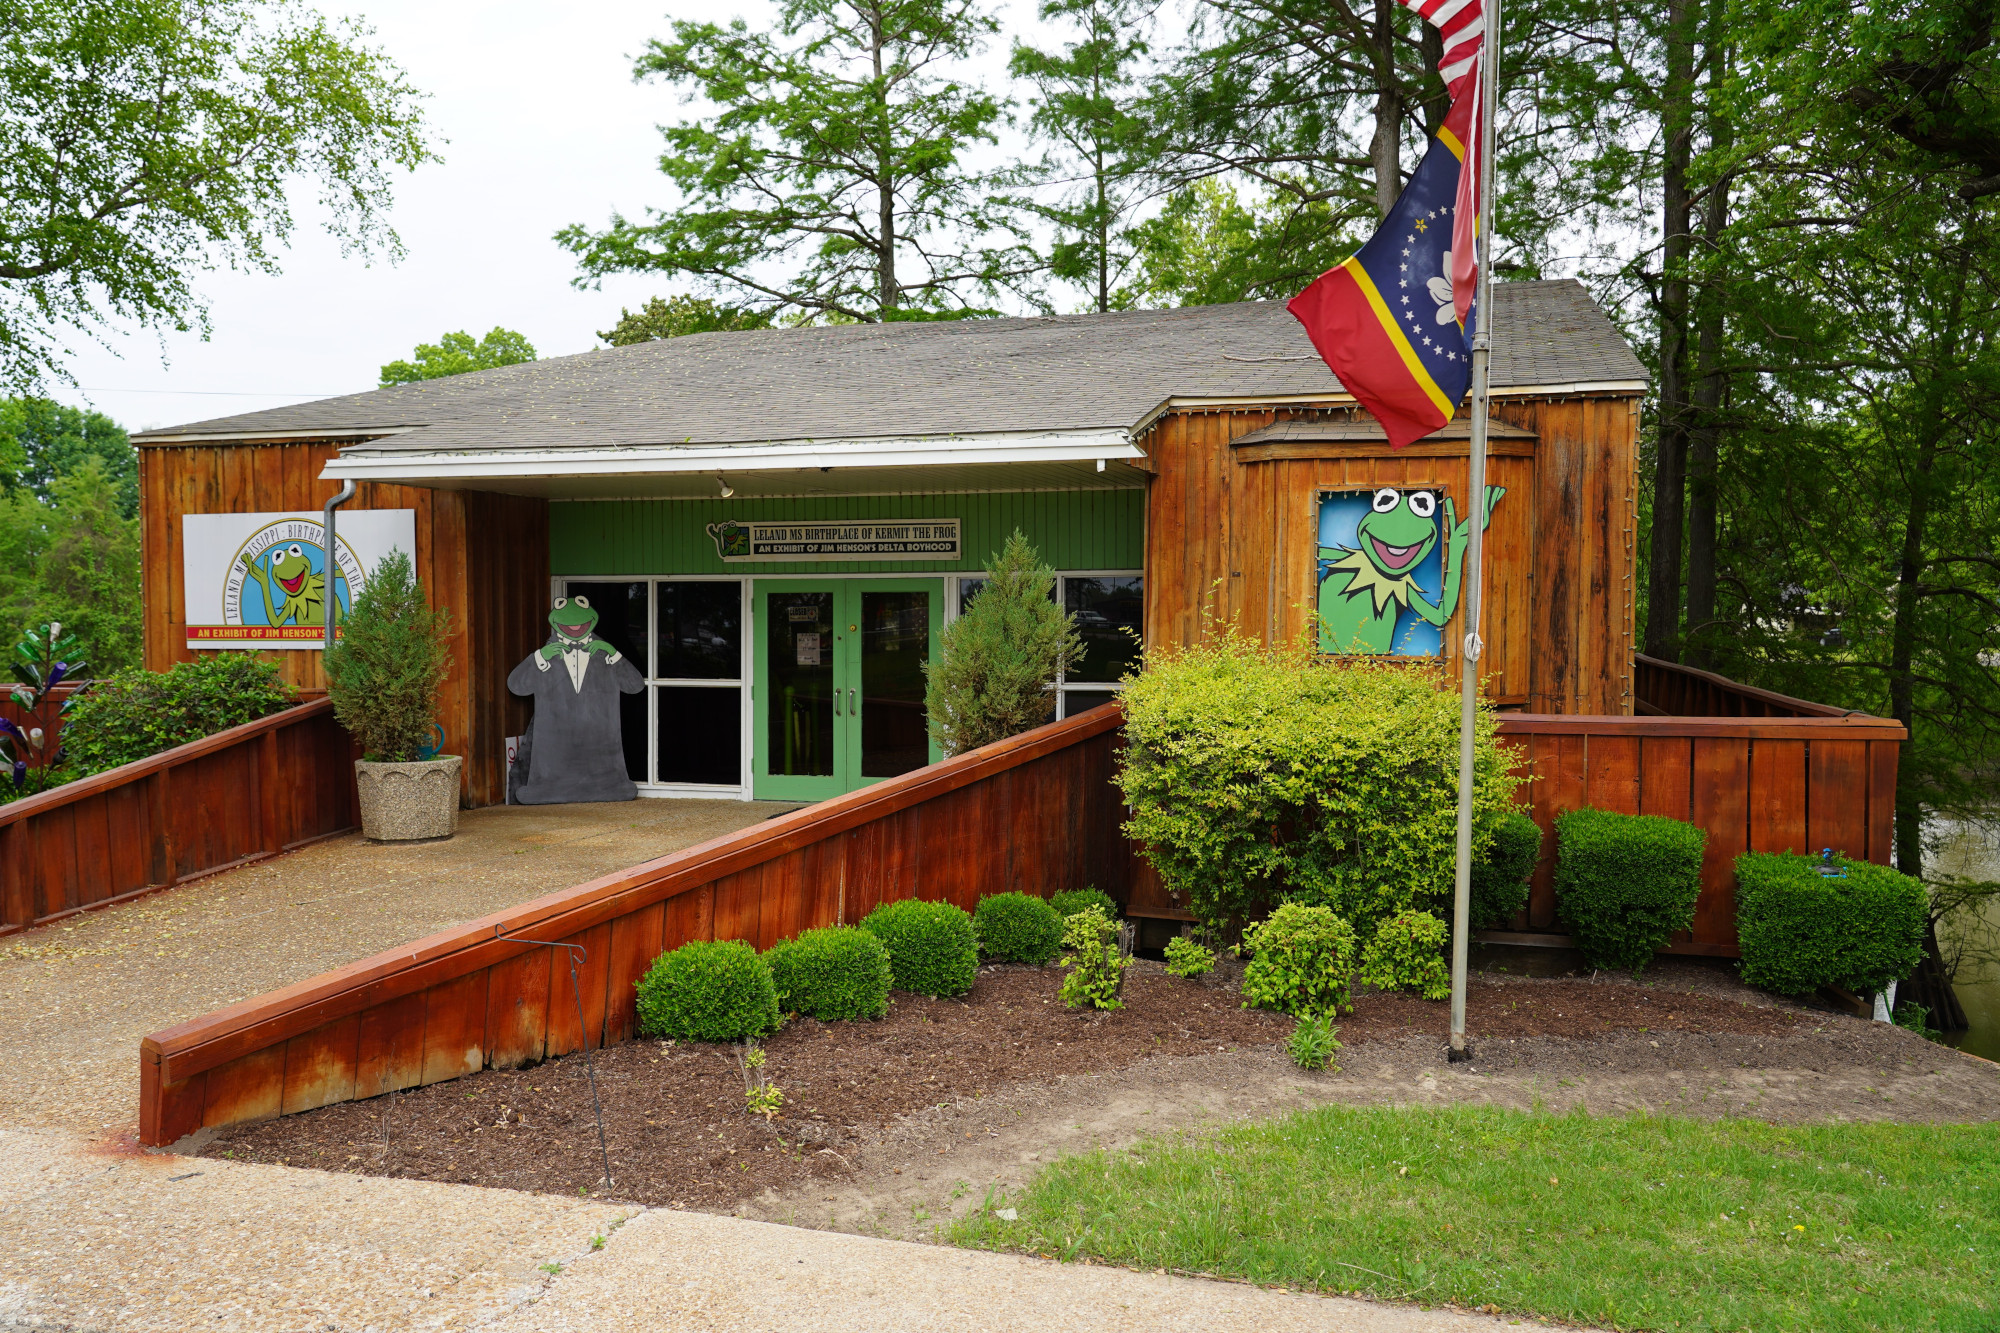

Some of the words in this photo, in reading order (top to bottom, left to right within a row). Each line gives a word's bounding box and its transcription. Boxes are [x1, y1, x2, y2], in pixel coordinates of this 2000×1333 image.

[754, 529, 787, 541] LELAND
[790, 528, 803, 540] MS
[805, 528, 859, 540] BIRTHPLACE
[861, 527, 873, 539] OF
[875, 527, 911, 539] KERMIT
[913, 526, 931, 539] THE
[933, 526, 957, 538] FROG
[758, 545, 771, 553] AN
[773, 544, 805, 553] EXHIBIT
[806, 544, 818, 552] OF
[820, 544, 834, 552] JIM
[836, 543, 876, 552] HENSON'S
[878, 543, 905, 552] DELTA
[907, 543, 952, 551] BOYHOOD
[234, 528, 280, 575] MIISSIPPI
[338, 552, 353, 567] OF
[347, 567, 362, 589] THE
[198, 629, 210, 638] AN
[213, 629, 248, 638] EXHIBIT
[251, 629, 263, 638] OF
[265, 629, 280, 638] JIM
